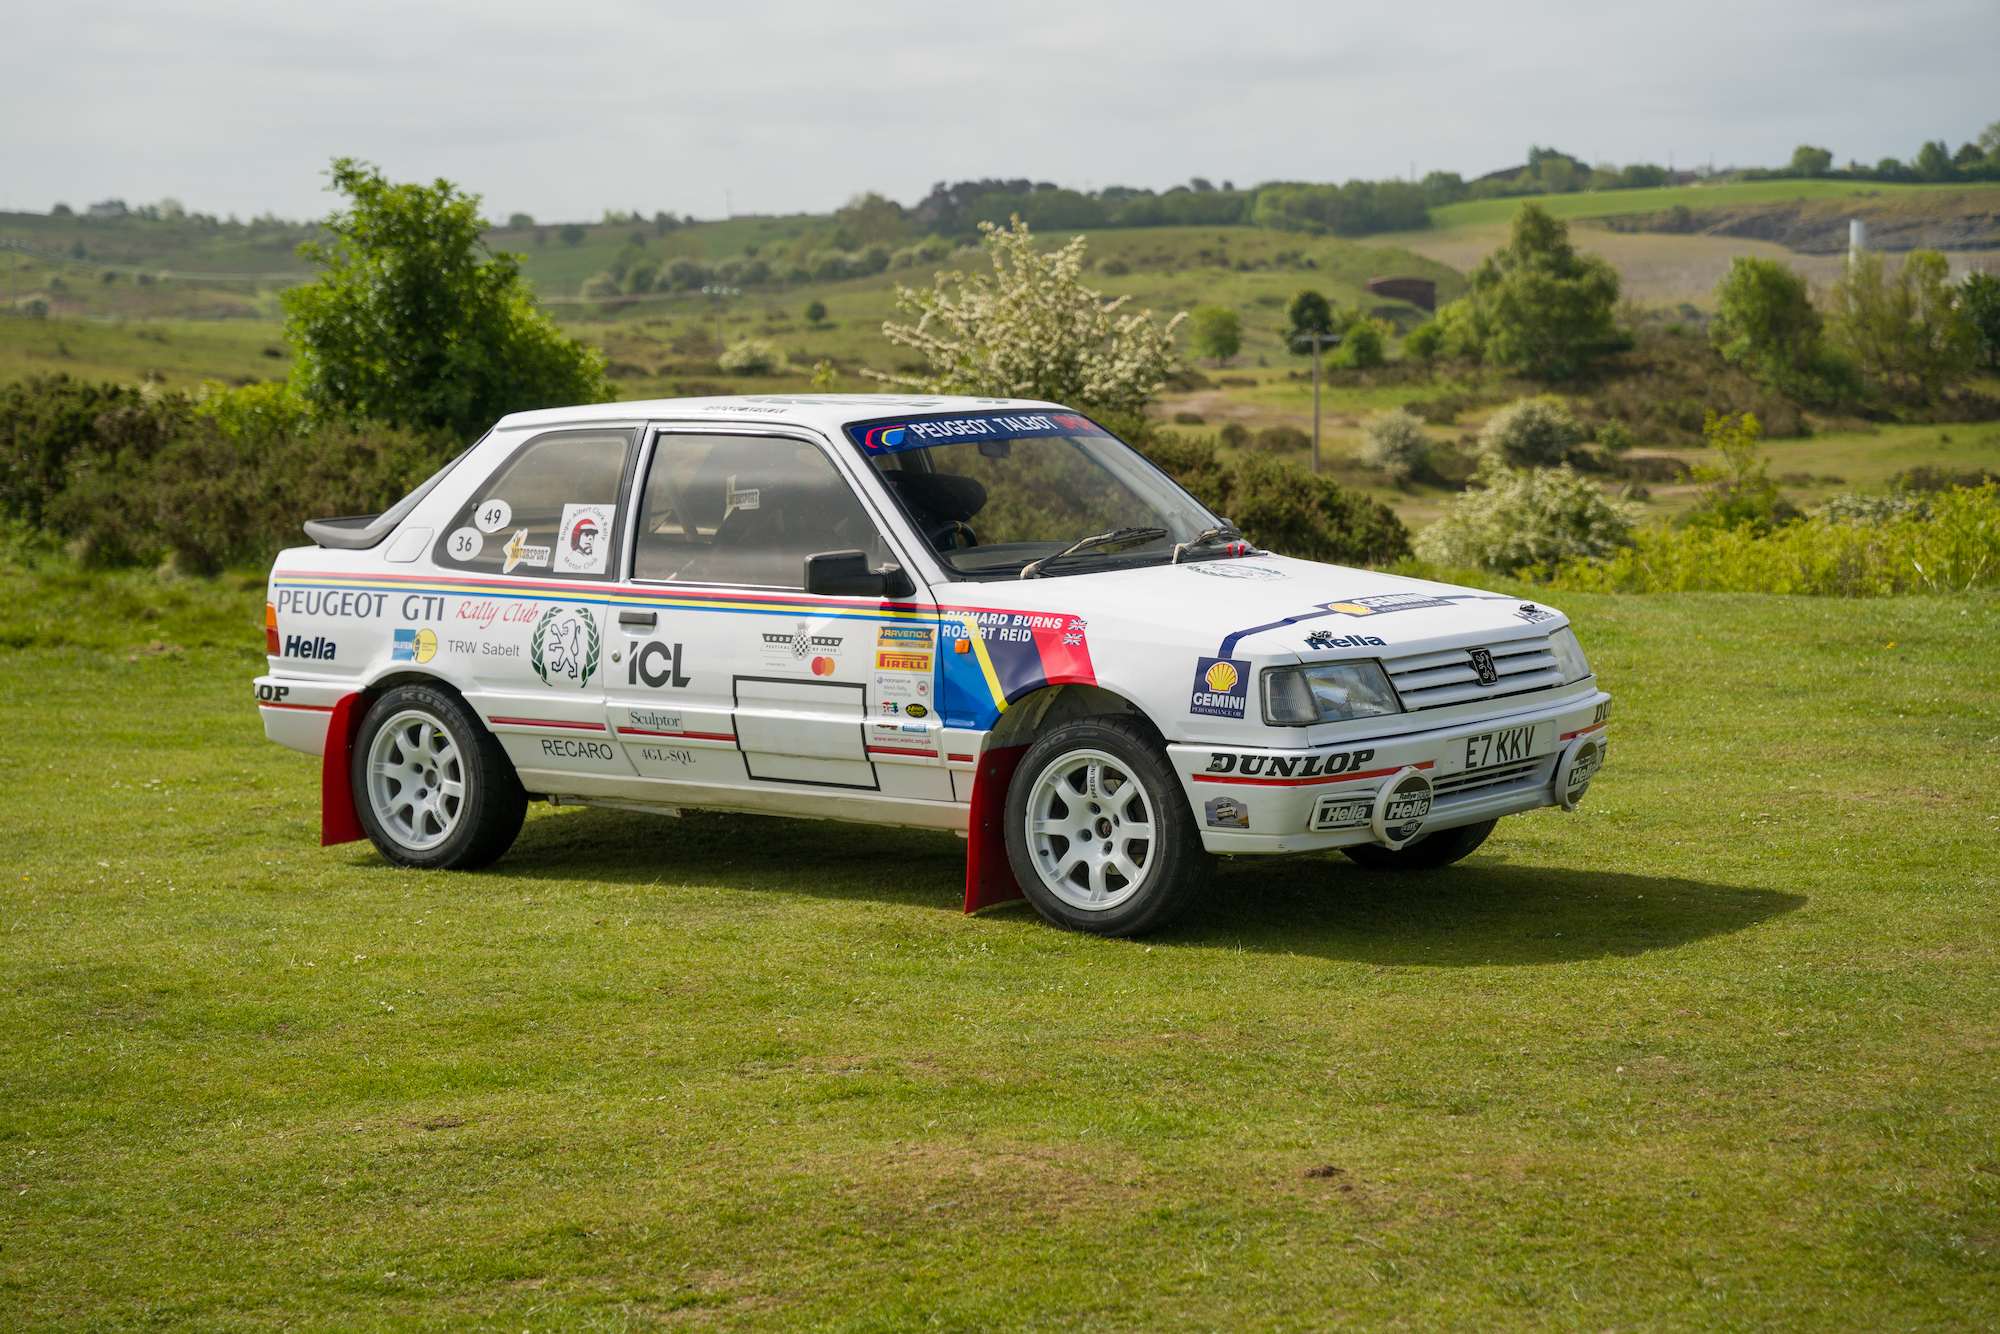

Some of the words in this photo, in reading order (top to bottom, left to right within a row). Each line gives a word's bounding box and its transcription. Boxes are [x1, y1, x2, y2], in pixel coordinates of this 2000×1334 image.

[908, 419, 996, 439] PEUGEOT
[993, 415, 1057, 432] TALBOT
[484, 509, 502, 525] 49
[560, 518, 572, 541] Roger
[573, 506, 592, 519] Albert
[592, 507, 606, 522] Clark
[600, 521, 609, 542] Rally
[456, 536, 473, 552] 36
[563, 556, 582, 570] Motor
[583, 557, 598, 570] Club
[277, 590, 388, 618] PEUGEOT
[402, 594, 445, 621] GTI
[455, 601, 500, 629] Rally
[503, 602, 539, 623] Club
[945, 610, 1008, 625] RICHARD
[1012, 616, 1064, 629] BURNS
[884, 629, 929, 639] RAVENOL
[942, 624, 996, 639] ROBERT
[999, 628, 1032, 642] REID
[284, 635, 337, 660] Hella
[393, 640, 413, 649] BILSTEIN
[448, 640, 478, 653] TRW
[482, 642, 520, 657] Sabelt
[628, 641, 691, 688] ICL
[879, 653, 929, 669] PIRELLI
[1193, 692, 1245, 710] GEMINI
[1191, 706, 1232, 715] PERFORMANCE
[630, 711, 680, 729] Sculptor
[541, 739, 613, 760] RECARO
[1465, 734, 1492, 769] E7
[1496, 726, 1536, 763] KKV
[641, 748, 696, 766] 4GL-SQL
[1205, 749, 1375, 777] DUNLOP
[1325, 805, 1368, 822] Hella
[1387, 800, 1430, 819] Hella
